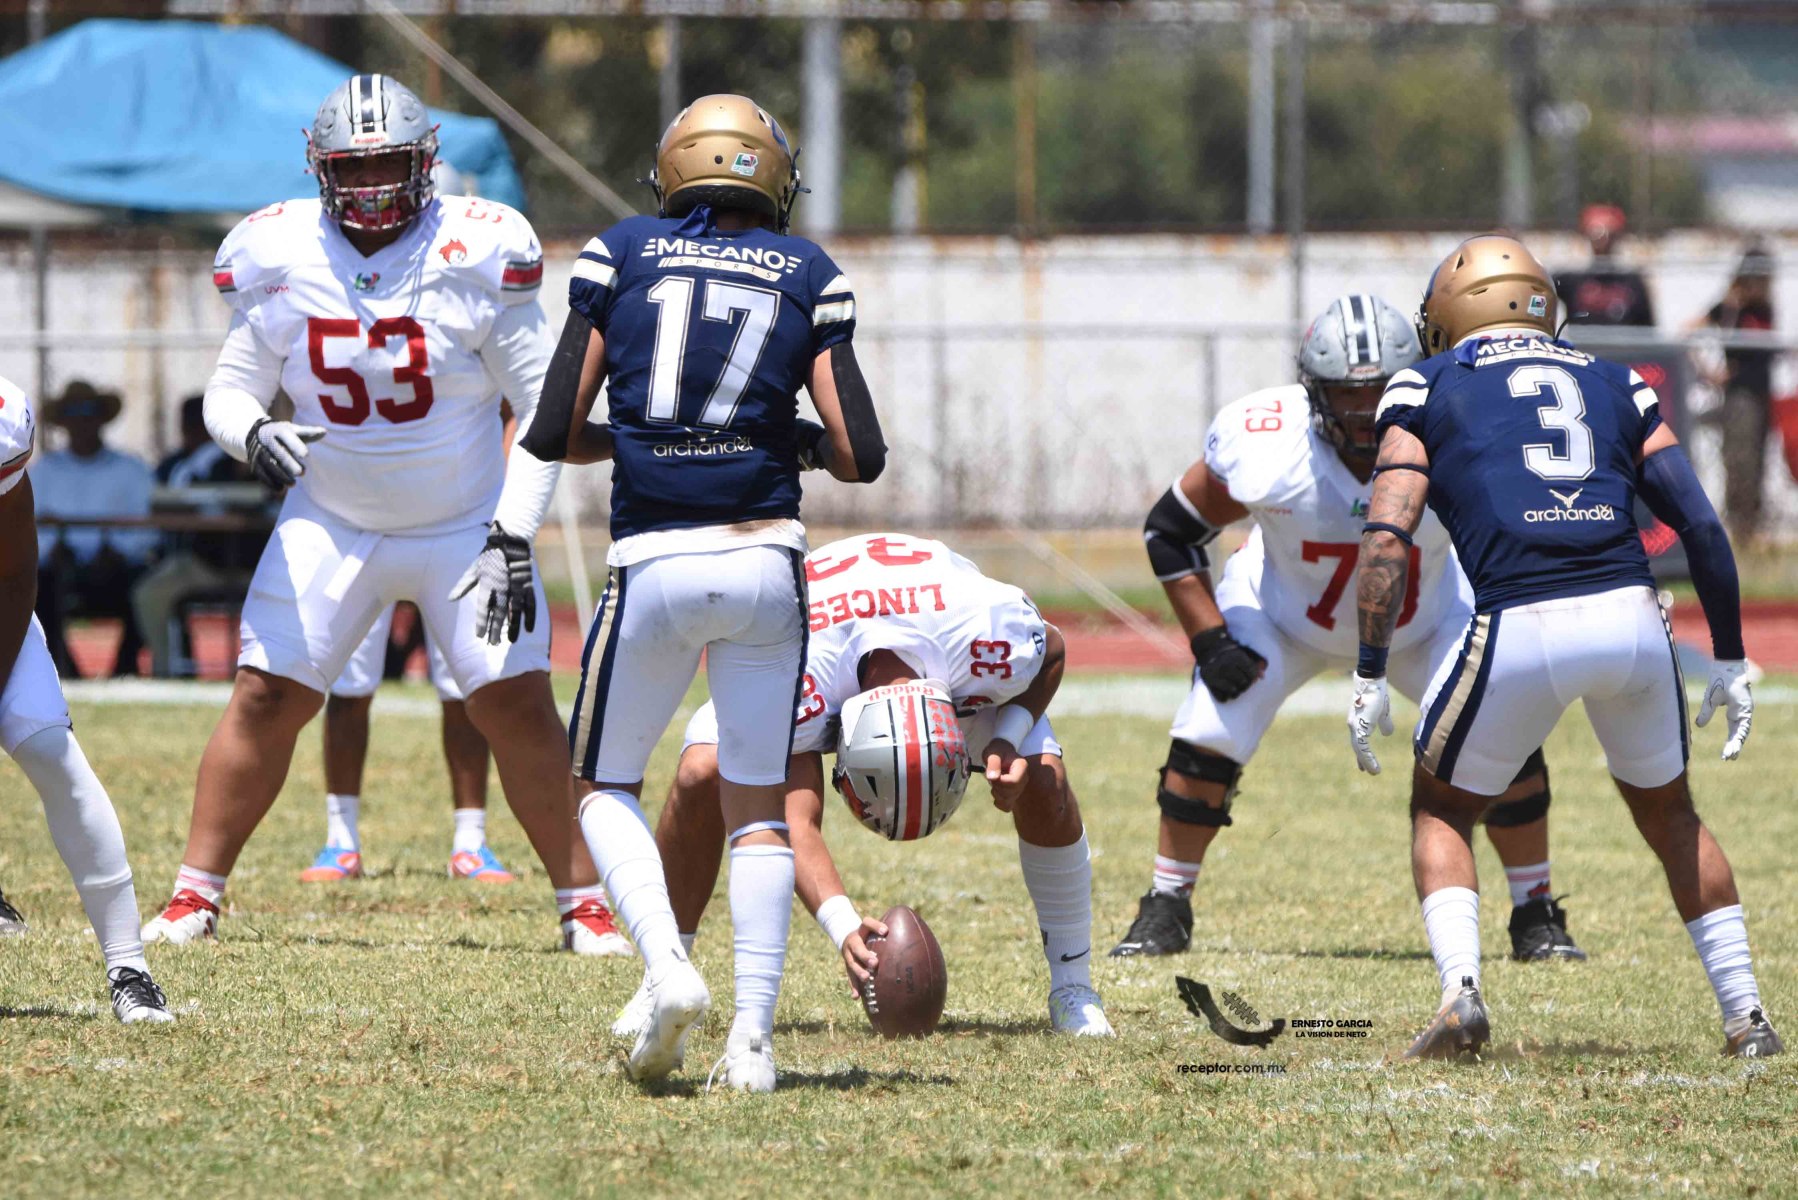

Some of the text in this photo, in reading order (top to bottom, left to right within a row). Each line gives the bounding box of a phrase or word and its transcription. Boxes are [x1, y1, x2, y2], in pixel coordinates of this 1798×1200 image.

[657, 238, 786, 270] MECANO
[678, 257, 773, 280] SPORTS
[308, 315, 434, 426] 53
[646, 275, 781, 429] 17
[1506, 365, 1596, 481] 3
[808, 583, 946, 633] LINCES
[970, 640, 1012, 680] 33
